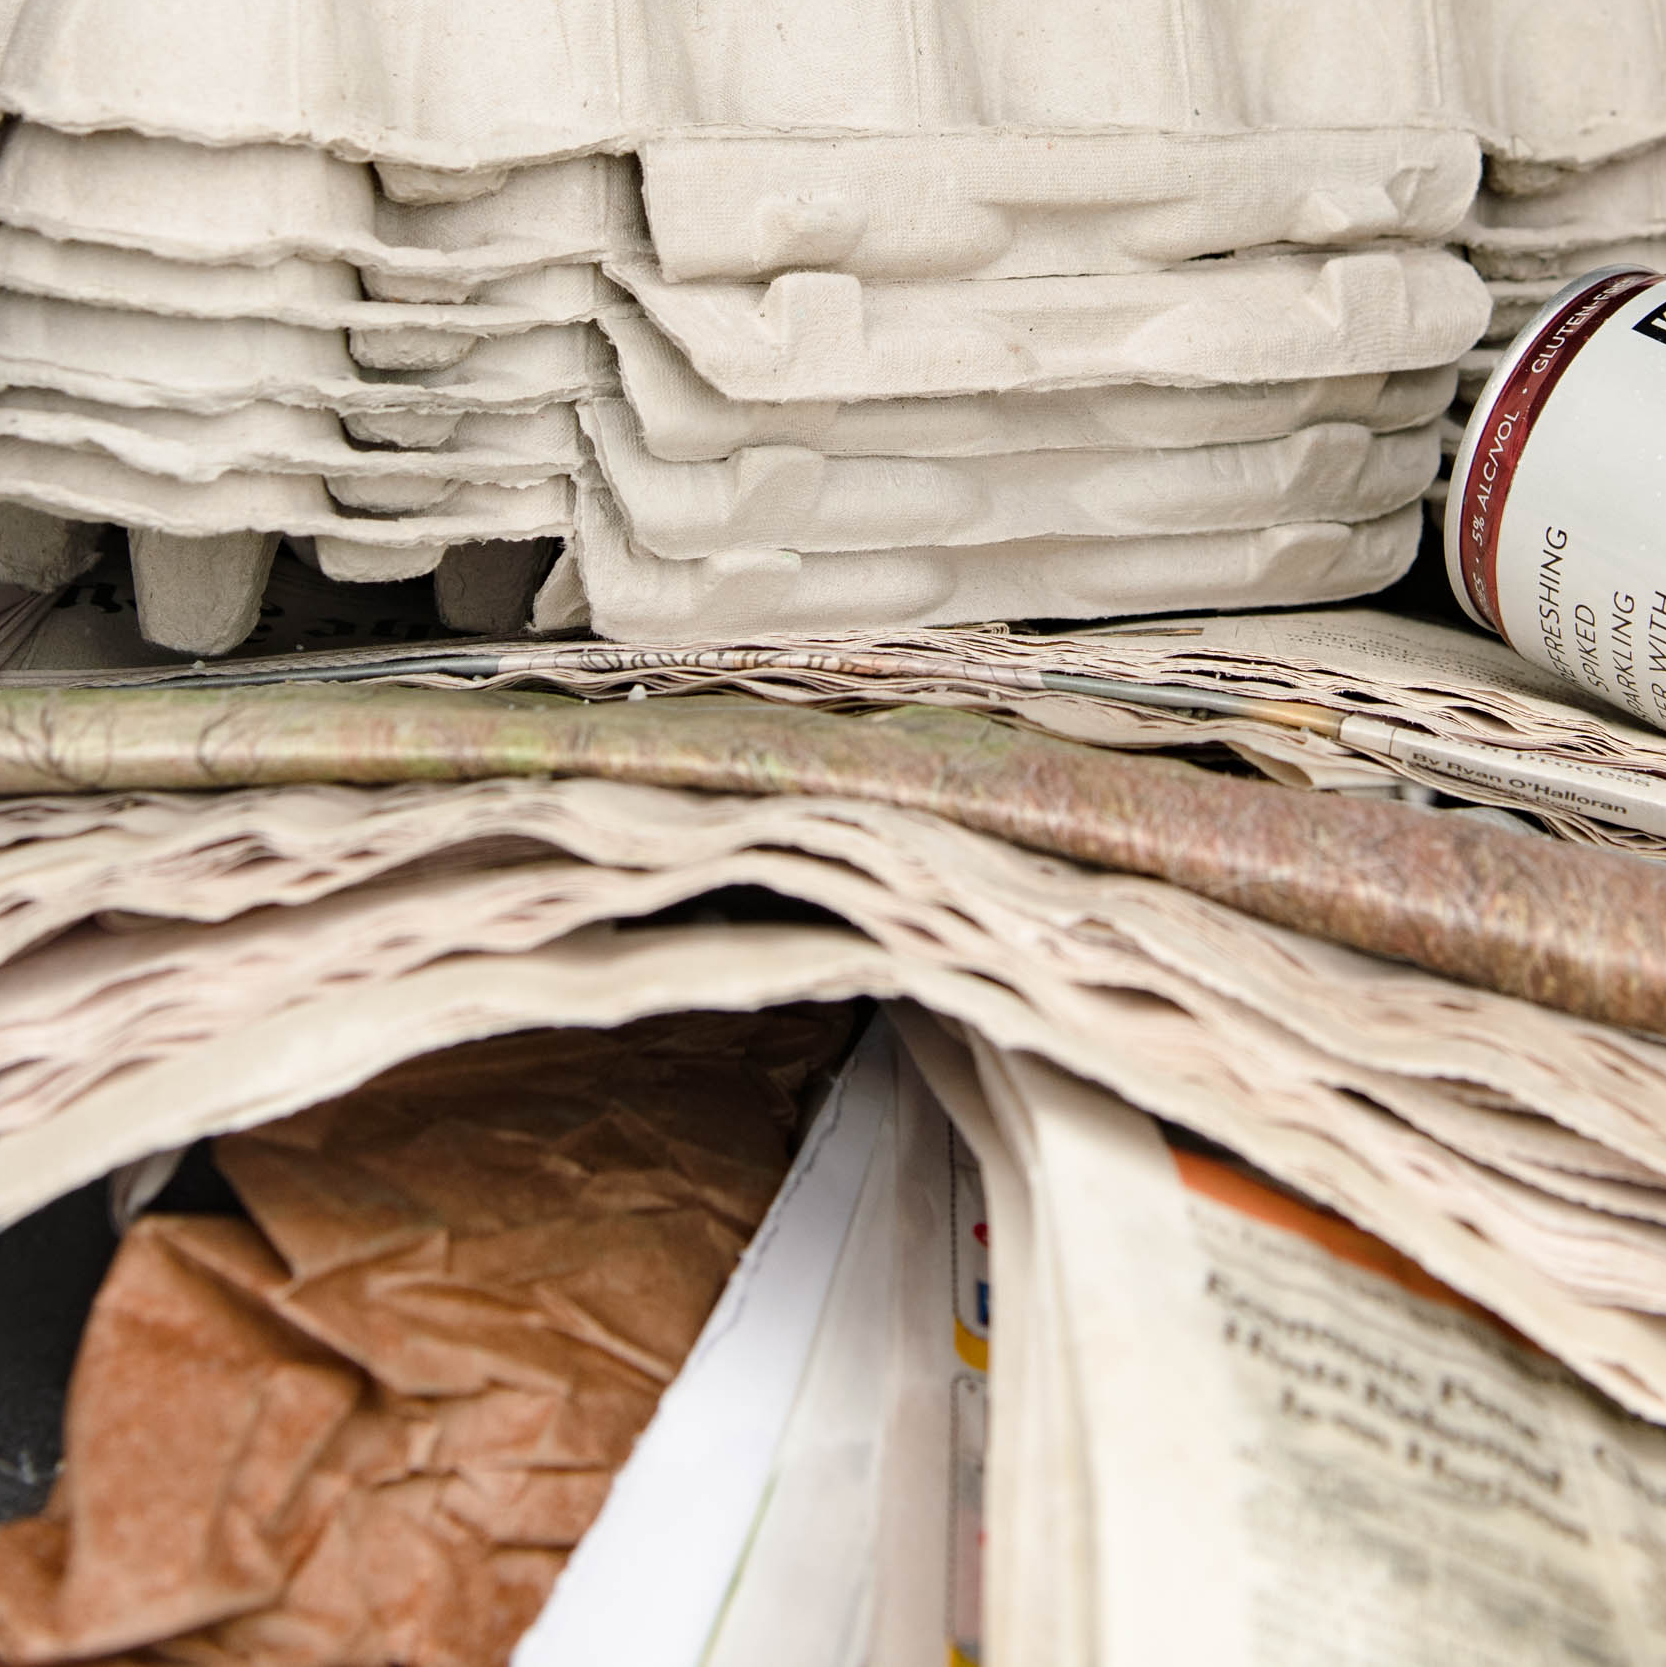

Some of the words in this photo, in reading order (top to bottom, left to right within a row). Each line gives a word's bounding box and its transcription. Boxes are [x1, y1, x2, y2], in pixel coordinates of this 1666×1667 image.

[1476, 409, 1520, 512] ALC/VOL
[1574, 603, 1610, 693] SPIKED
[1411, 751, 1441, 767] By
[1444, 756, 1503, 784] Ryan
[1508, 777, 1629, 816] O'Halloran
